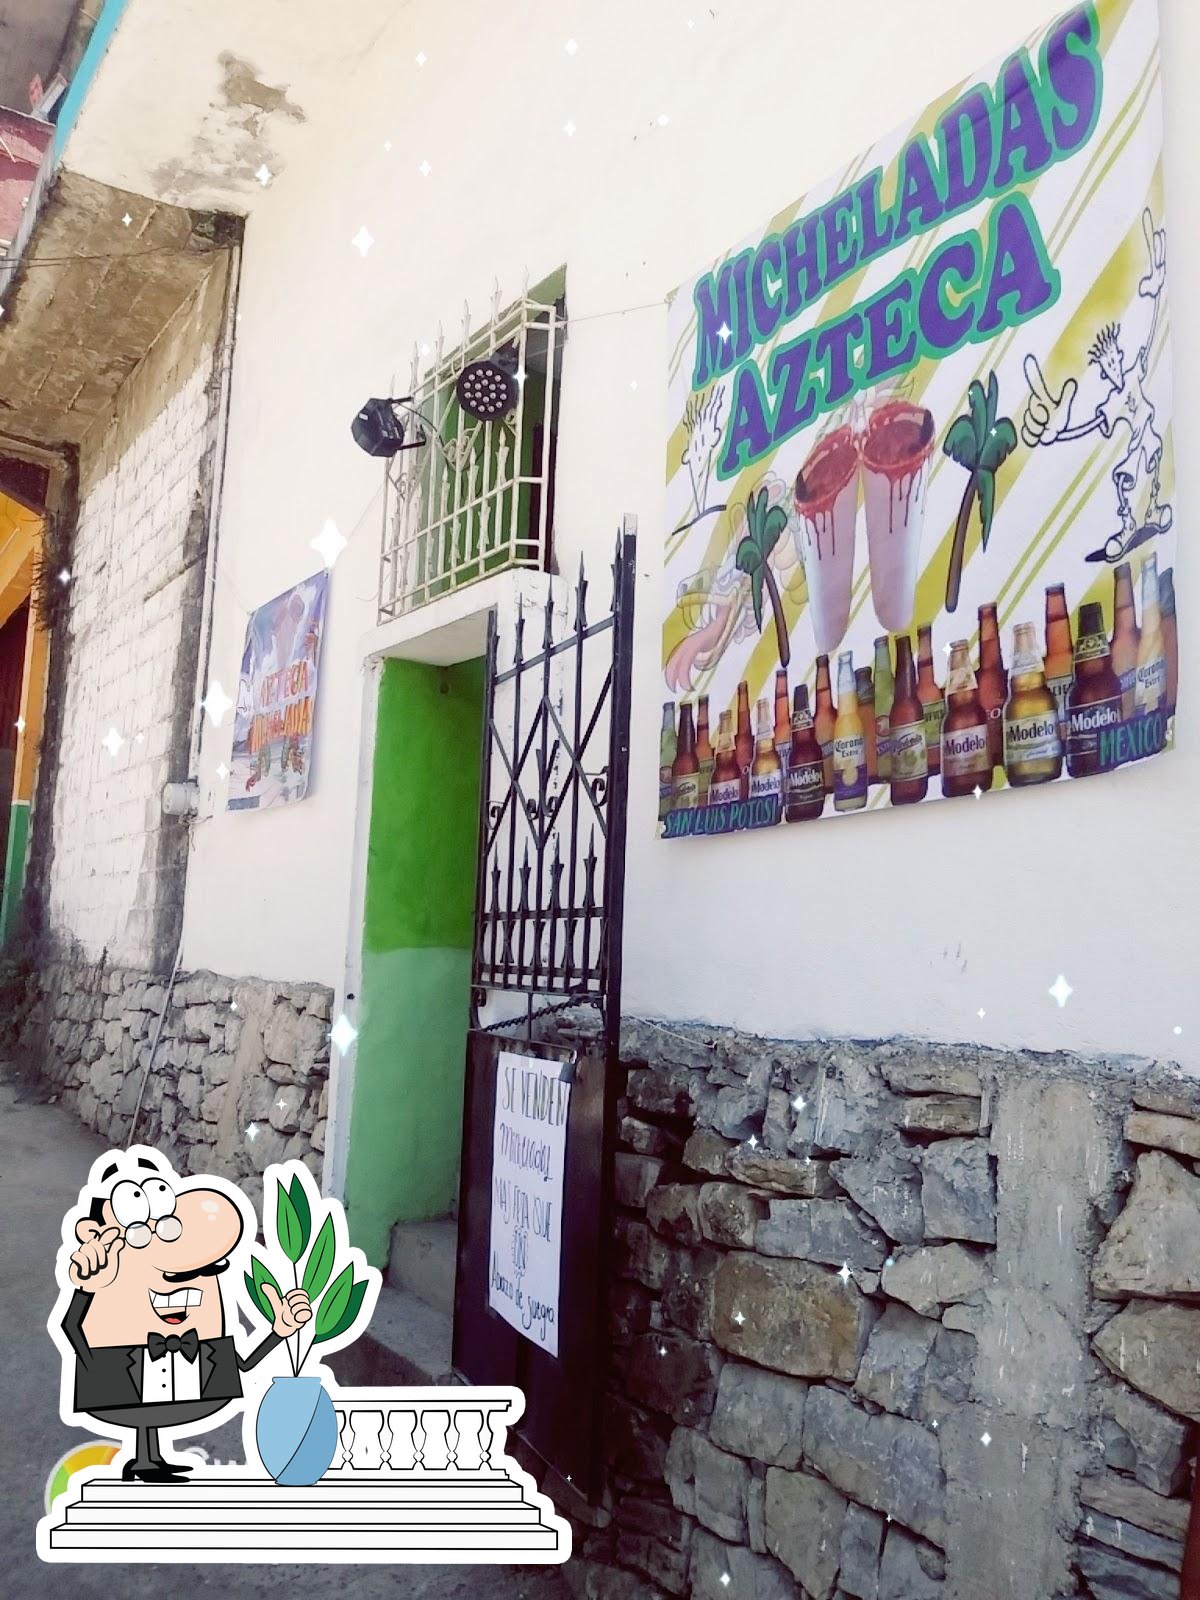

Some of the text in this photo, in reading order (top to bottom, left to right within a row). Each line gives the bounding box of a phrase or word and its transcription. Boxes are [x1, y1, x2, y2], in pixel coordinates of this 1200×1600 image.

[694, 2, 1101, 389] MICHELADAS
[717, 191, 1060, 481] AZTECA
[1008, 720, 1055, 744] Modelo
[1071, 707, 1119, 732] Modelo
[944, 735, 986, 756] Modelo
[1100, 713, 1164, 766] MEXICO
[666, 810, 691, 835] SAN
[521, 1069, 568, 1127] VENDEN
